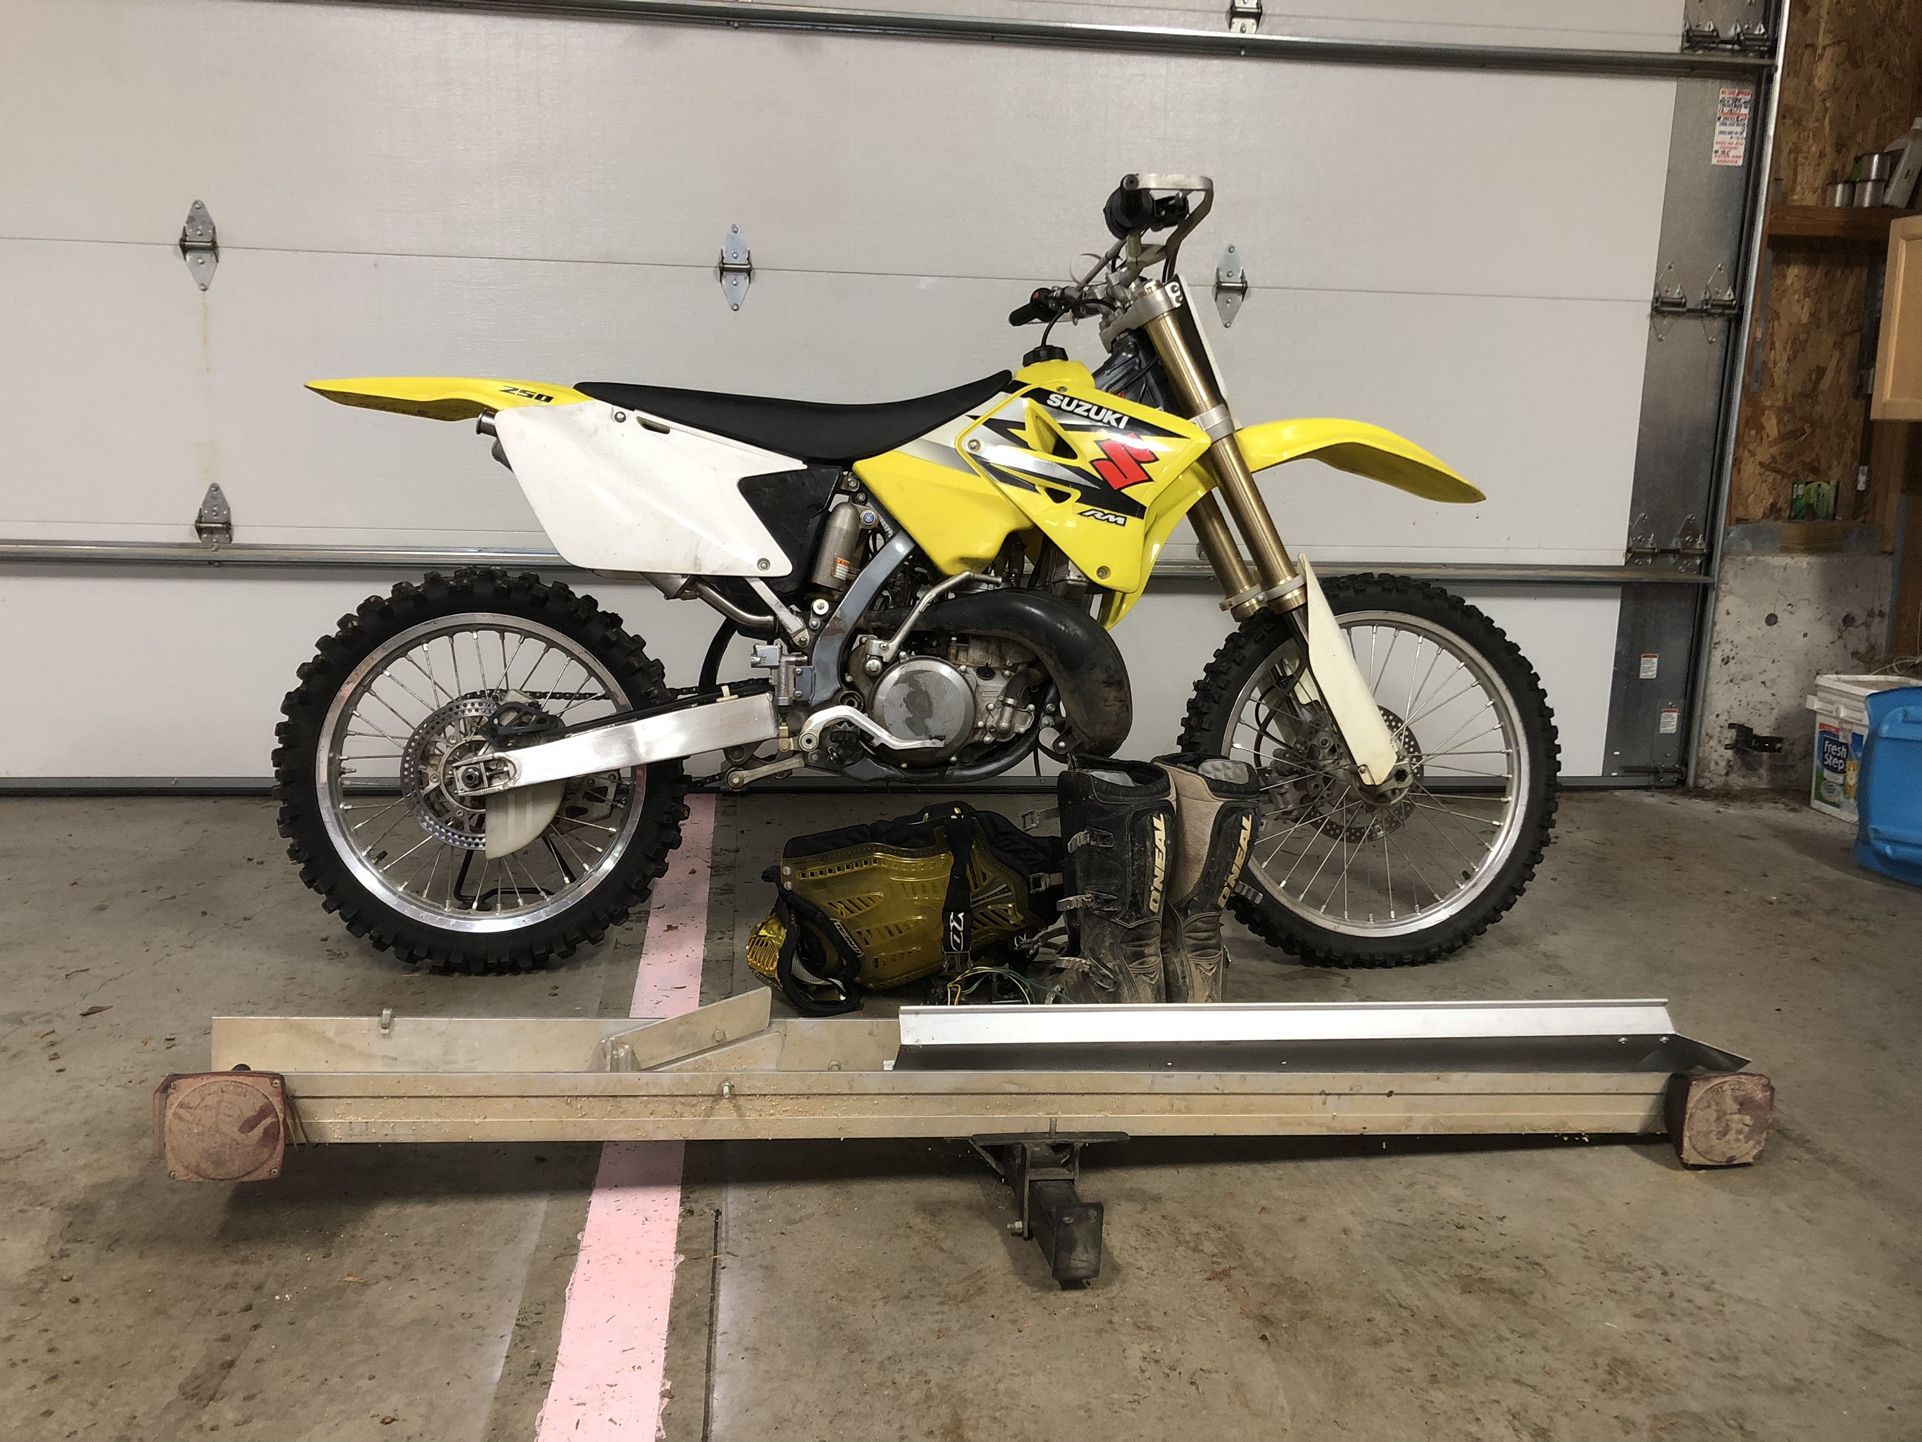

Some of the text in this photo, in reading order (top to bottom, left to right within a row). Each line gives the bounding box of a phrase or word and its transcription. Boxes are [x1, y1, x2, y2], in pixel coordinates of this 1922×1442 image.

[498, 385, 553, 402] 250
[1046, 393, 1130, 429] SUZUKI
[1080, 510, 1126, 525] RM
[1824, 740, 1846, 757] Fresh
[1824, 753, 1844, 770] Step
